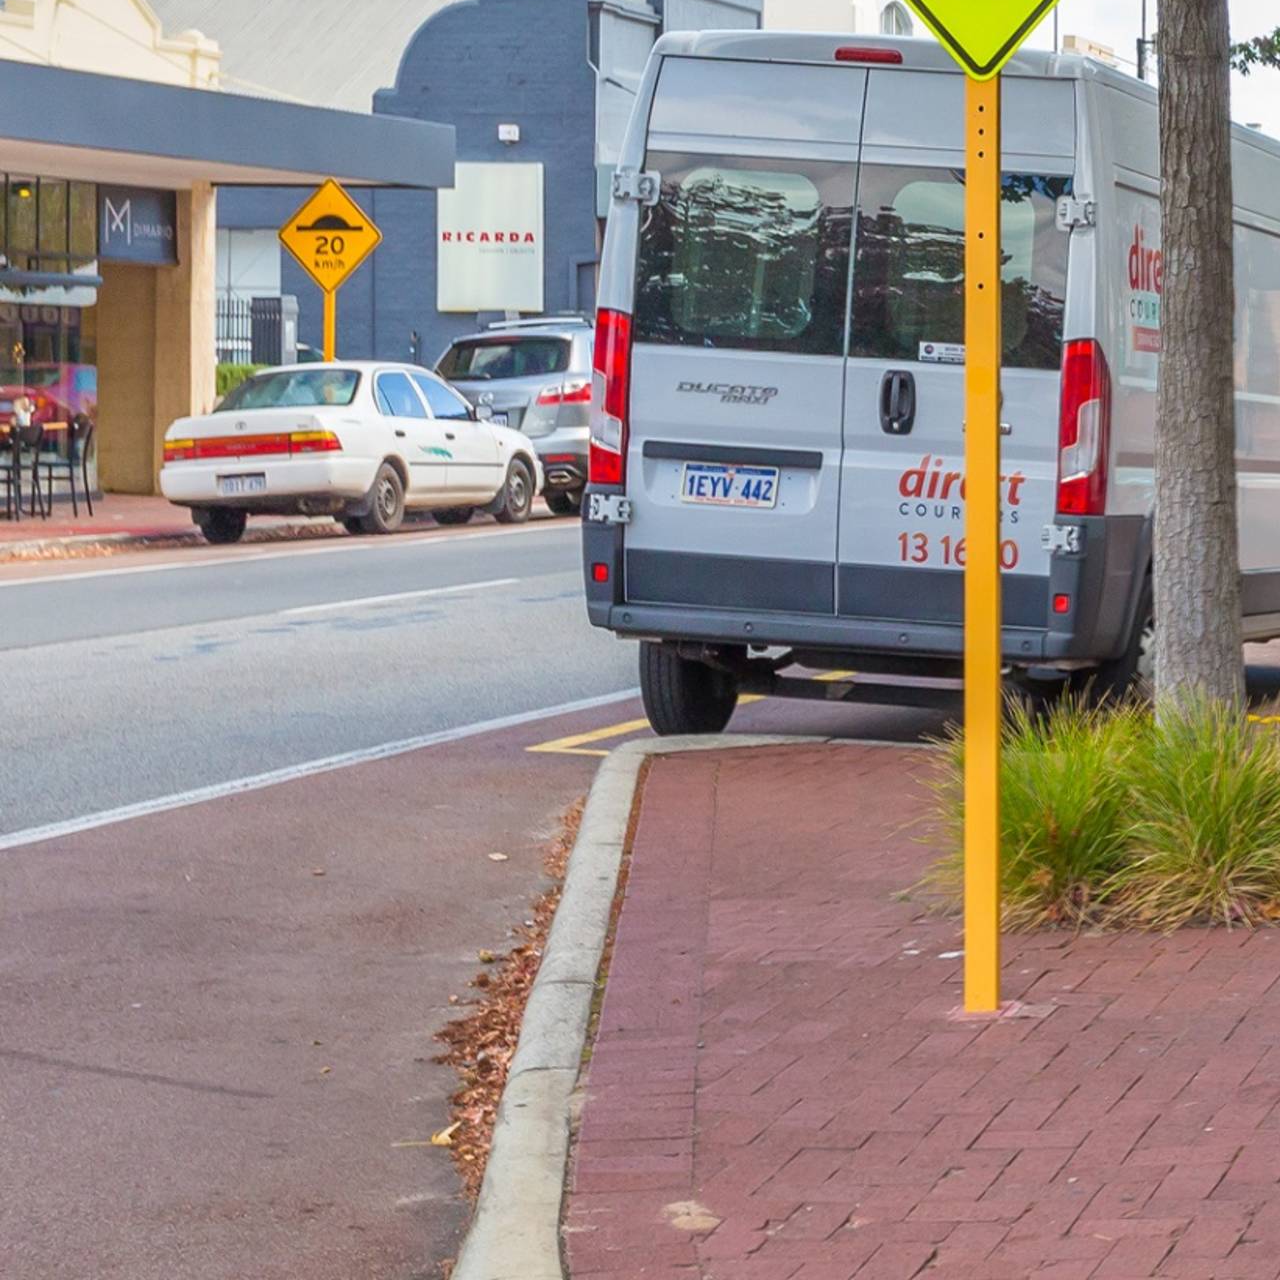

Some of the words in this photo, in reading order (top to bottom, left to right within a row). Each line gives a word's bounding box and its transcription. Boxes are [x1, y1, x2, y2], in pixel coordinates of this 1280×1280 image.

[314, 235, 345, 255] 20
[442, 231, 535, 243] RICARDA
[314, 258, 346, 270] km/h
[1128, 223, 1164, 295] dire
[676, 381, 779, 398] DUCATO
[898, 453, 1026, 506] dirt
[898, 532, 929, 563] 13
